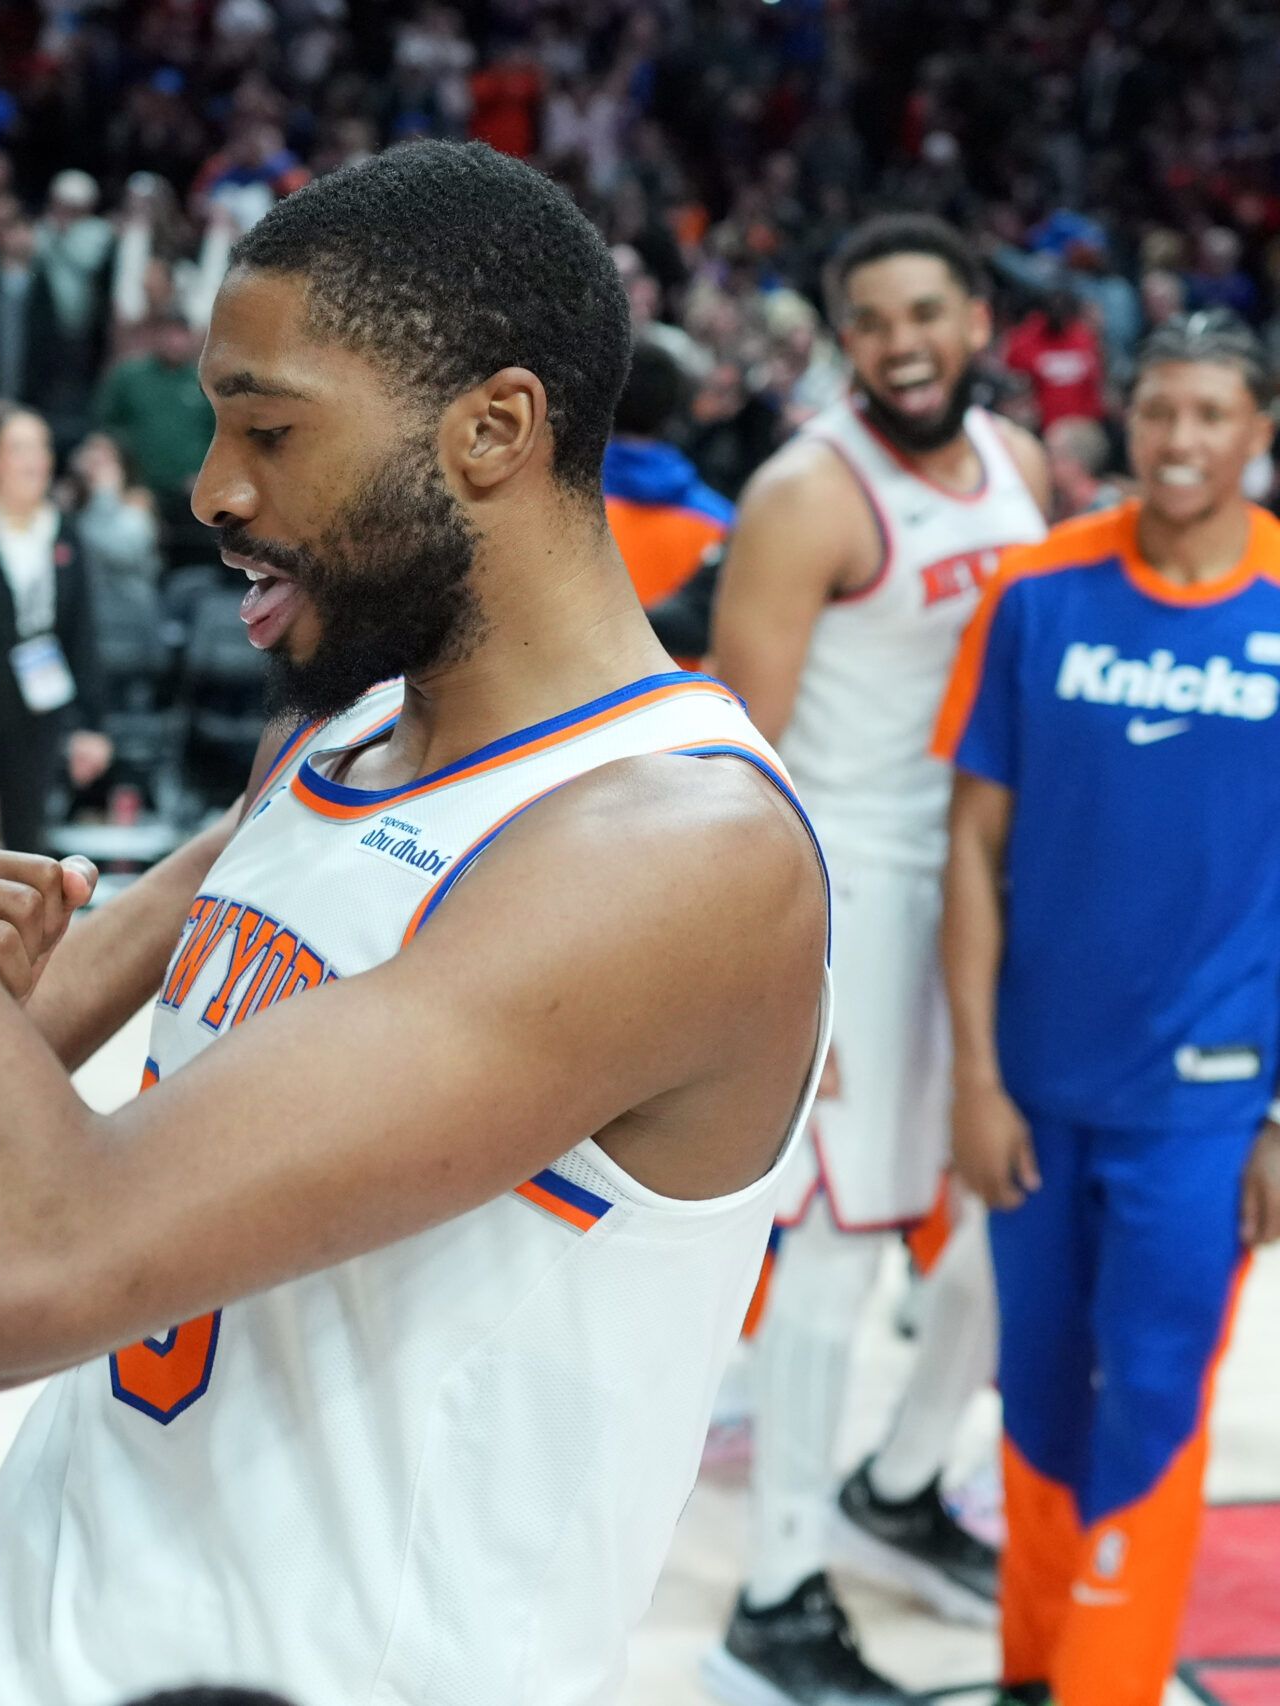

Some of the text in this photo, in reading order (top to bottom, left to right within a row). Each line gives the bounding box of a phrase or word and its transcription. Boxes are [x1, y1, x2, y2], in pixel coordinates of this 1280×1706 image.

[1055, 641, 1280, 721] Knicks
[360, 828, 452, 876] abu dhabi
[380, 816, 422, 835] experience
[201, 904, 339, 1032] YO
